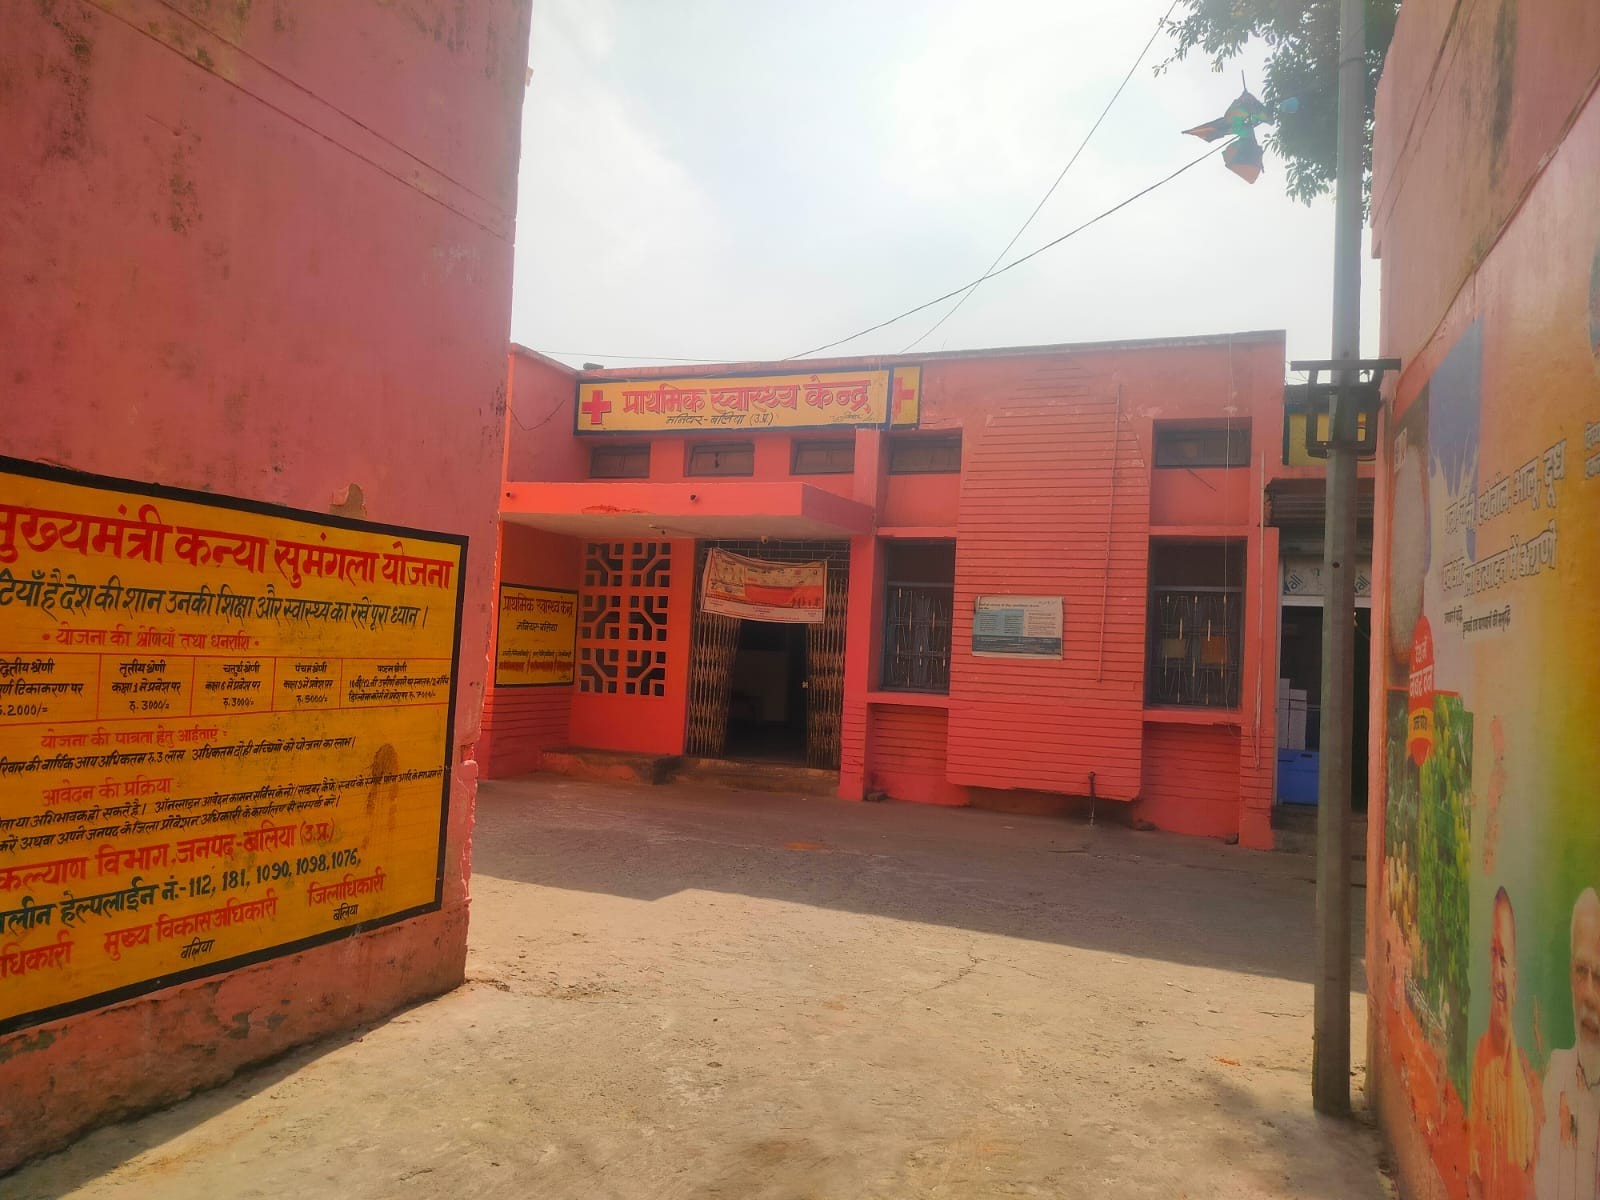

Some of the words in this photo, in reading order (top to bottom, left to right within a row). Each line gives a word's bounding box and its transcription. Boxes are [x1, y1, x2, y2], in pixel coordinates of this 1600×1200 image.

[622, 382, 706, 415] प्राथमिक
[709, 384, 800, 414] स्वास्थ्य
[803, 374, 872, 414] केन्द्र
[175, 526, 270, 576] कन्या
[274, 531, 380, 589] सुमंगला
[381, 540, 454, 590] योजना
[62, 574, 96, 617] देश
[94, 574, 124, 610] की
[125, 586, 167, 619] शान
[166, 584, 216, 616] उनकी
[216, 583, 255, 627] शिक्षा
[255, 583, 283, 626] और
[283, 597, 333, 629] स्वास्थ्य
[331, 600, 351, 623] का
[370, 603, 392, 631] पूरा
[502, 592, 535, 613] प्राथमिक
[55, 620, 108, 646] योजना
[109, 624, 130, 647] की
[179, 632, 208, 649] तथा
[211, 629, 250, 650] धनराशि
[119, 658, 145, 680] तृतीय
[71, 682, 84, 698] पर
[40, 727, 88, 749] योजना
[91, 726, 109, 748] की
[114, 730, 153, 746] पात्रता
[155, 724, 175, 748] हेतु
[25, 755, 42, 772] की
[41, 753, 73, 771] वार्षिक
[75, 756, 99, 769] आय
[98, 750, 149, 768] अधिकतम
[192, 743, 234, 761] अधिकतम
[295, 736, 323, 751] योजना
[43, 778, 95, 807] आवेदन
[98, 776, 121, 799] की
[124, 774, 174, 796] प्रक्रिया
[15, 816, 31, 828] या
[86, 804, 100, 821] हो
[102, 802, 132, 820] सकते
[201, 791, 229, 808] आवेदन
[19, 835, 53, 851] अथवा
[57, 825, 84, 845] अपने
[86, 824, 121, 841] जनपद
[132, 819, 158, 836] जिला
[0, 856, 89, 892] कल्याण
[307, 865, 386, 907] जिलाधिकारी
[60, 876, 160, 929] हेल्पलाईन
[333, 901, 359, 922] बलिया
[103, 923, 152, 962] मुख्य
[156, 912, 211, 942] विकास
[213, 887, 279, 928] अधिकारी
[179, 935, 216, 962] बलिया
